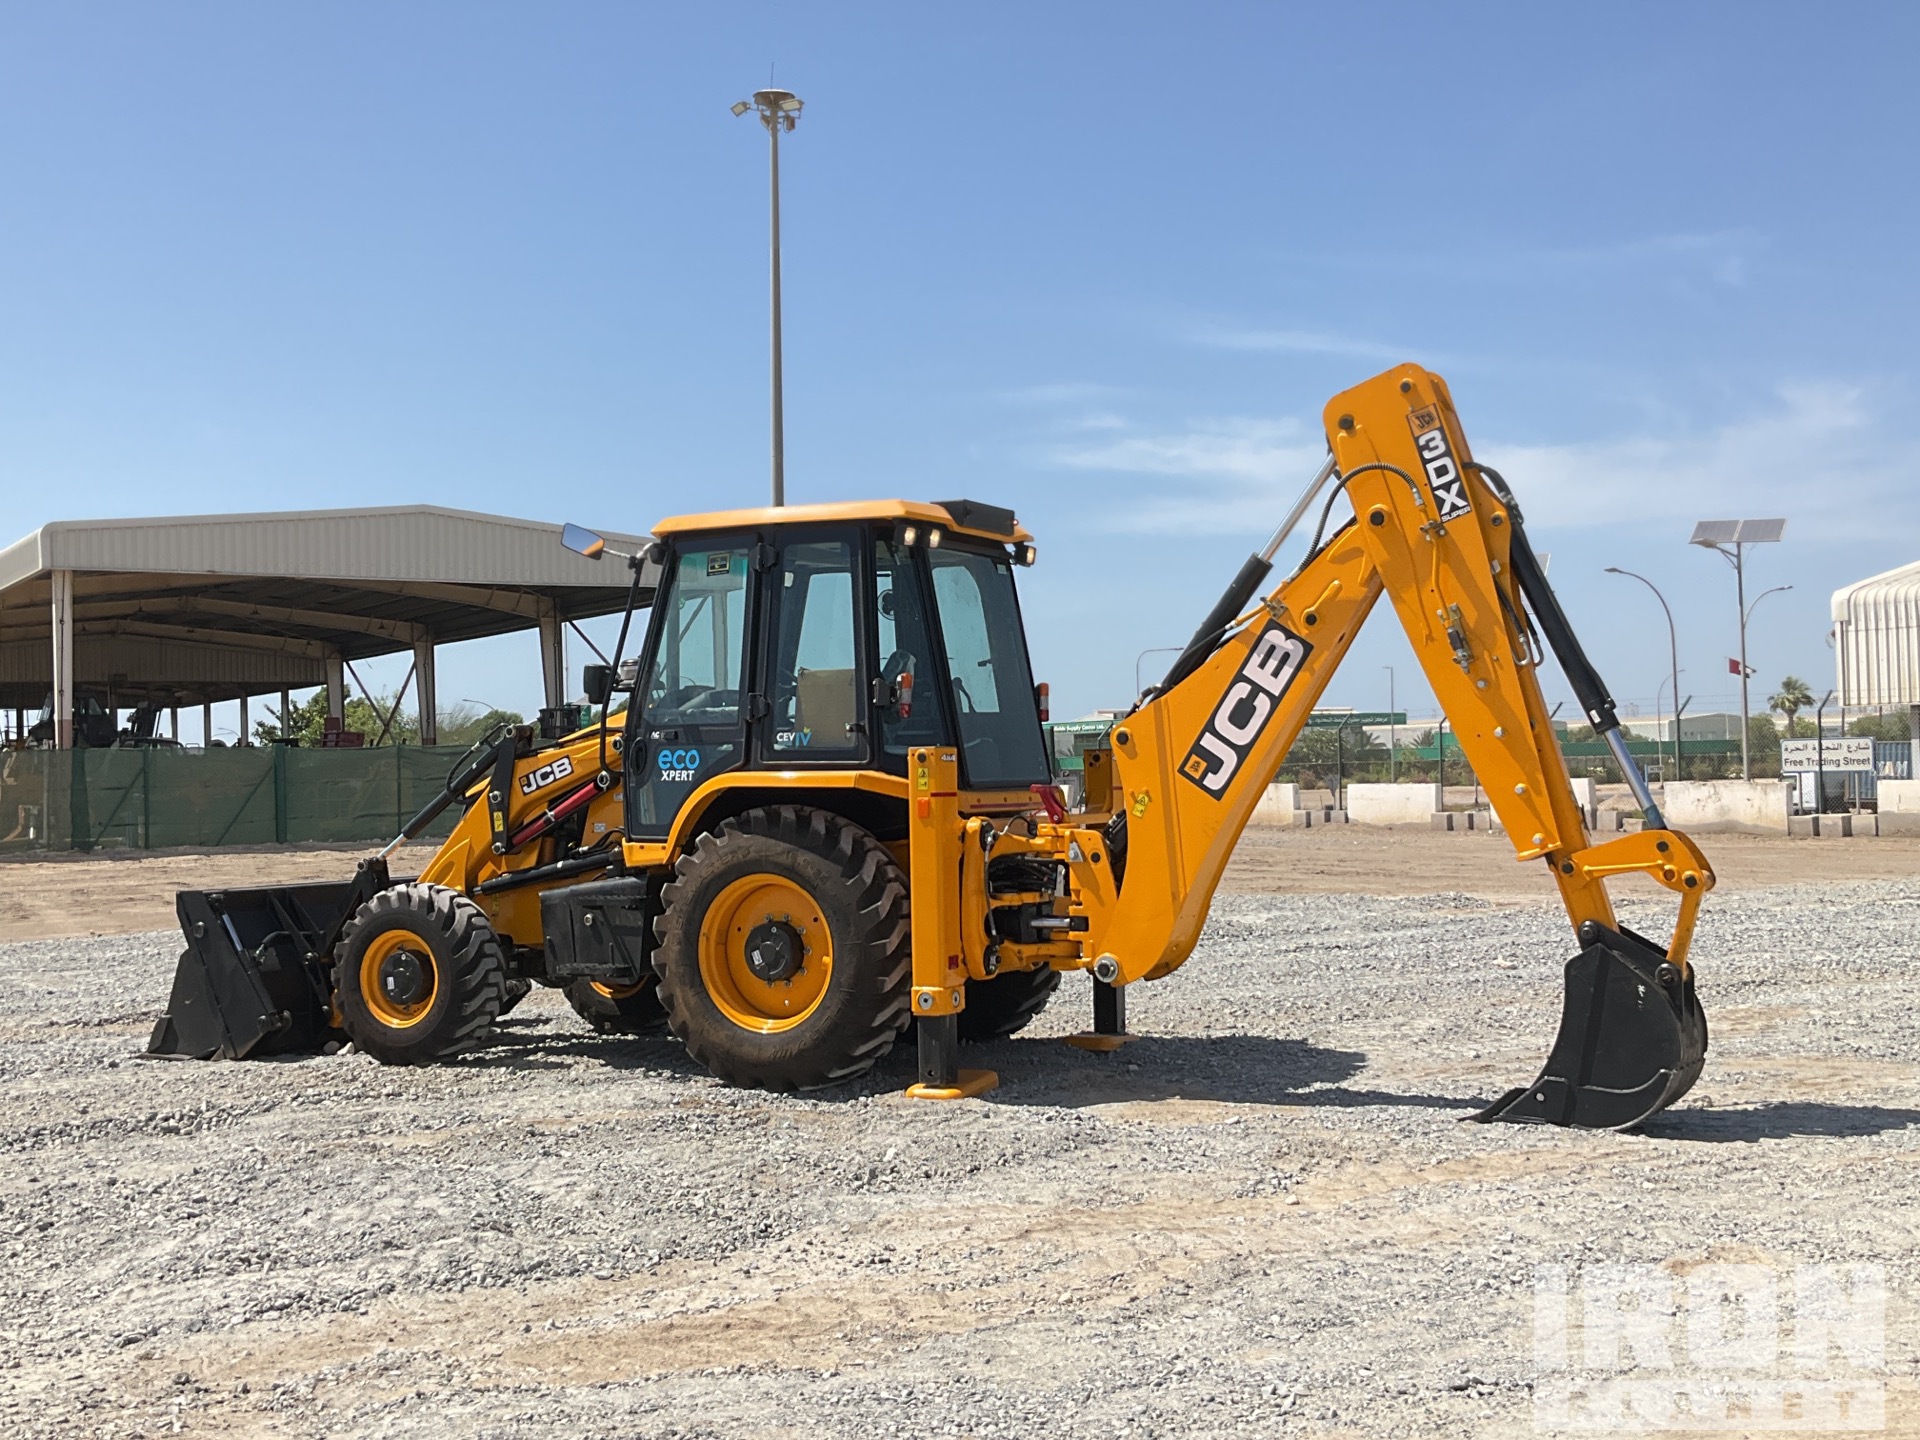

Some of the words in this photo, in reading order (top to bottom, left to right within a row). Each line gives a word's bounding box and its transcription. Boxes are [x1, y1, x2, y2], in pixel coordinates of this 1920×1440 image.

[1414, 411, 1435, 430] JCB
[1418, 430, 1468, 515] 3DX
[1441, 506, 1471, 522] SUPER
[1199, 629, 1304, 791] JCB
[776, 732, 795, 742] CEV
[1784, 743, 1808, 753] الحرة
[1847, 742, 1870, 753] شارع
[658, 749, 700, 770] eco
[1784, 757, 1803, 766] Free
[1843, 756, 1870, 765] Street
[523, 757, 572, 793] JCB
[661, 770, 695, 781] XPERT
